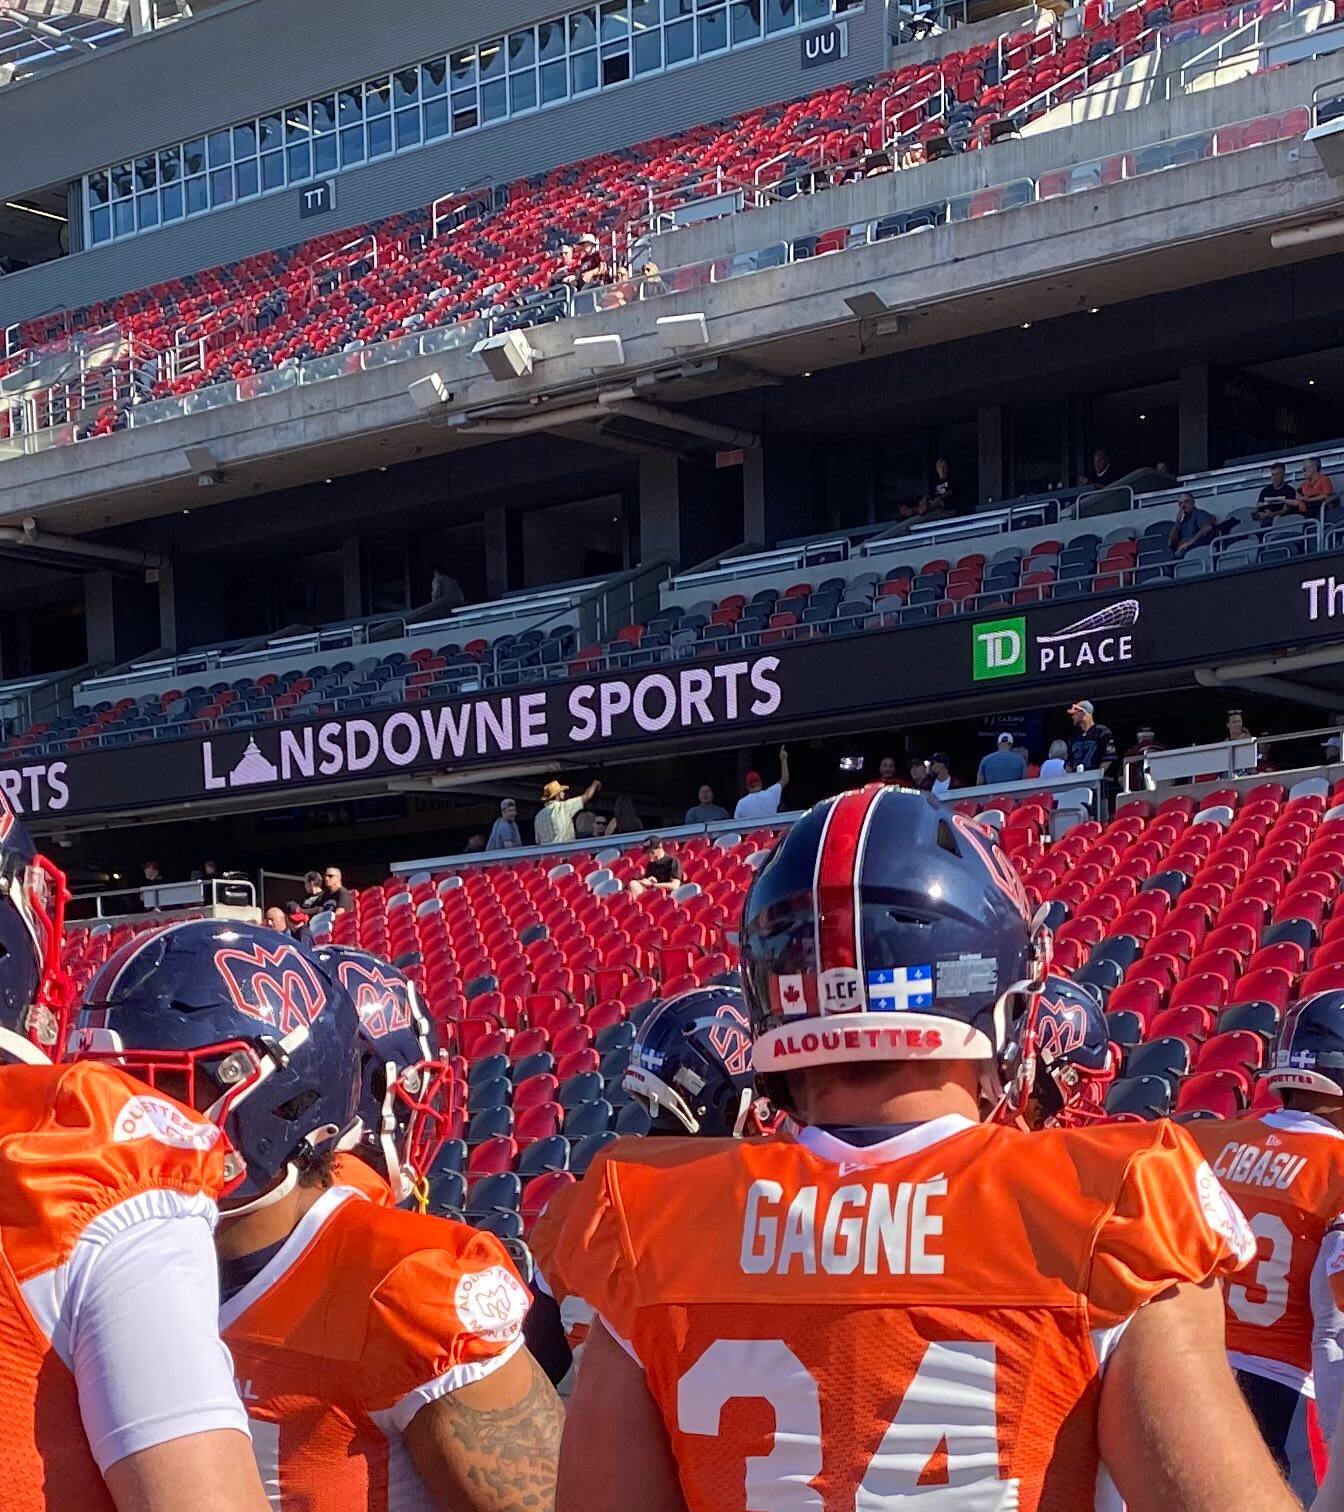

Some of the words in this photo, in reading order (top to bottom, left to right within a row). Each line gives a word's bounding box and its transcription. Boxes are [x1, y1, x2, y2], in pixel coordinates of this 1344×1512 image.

[806, 31, 835, 58] UU
[304, 187, 325, 209] TT
[977, 630, 1021, 671] TD
[1040, 635, 1133, 672] PLACE
[568, 655, 783, 742] SPORTS
[1, 761, 69, 813] RTS
[825, 980, 857, 1000] LCF
[773, 1027, 944, 1058] ALOUETTES
[1212, 1140, 1308, 1190] CIBASU
[739, 1171, 947, 1277] GAGNÉ
